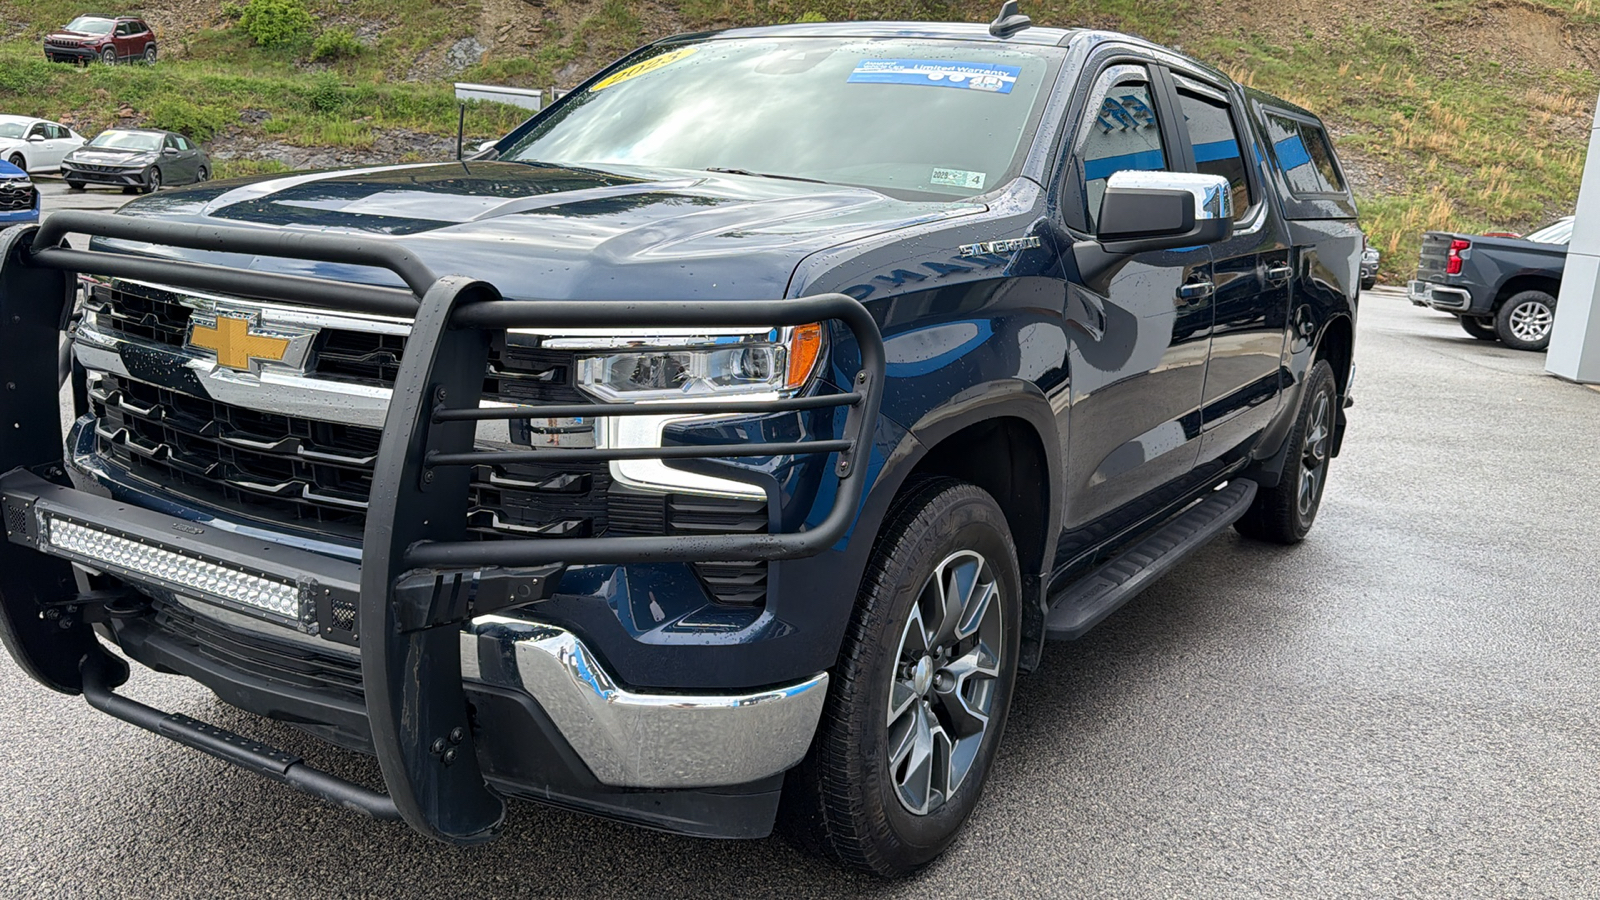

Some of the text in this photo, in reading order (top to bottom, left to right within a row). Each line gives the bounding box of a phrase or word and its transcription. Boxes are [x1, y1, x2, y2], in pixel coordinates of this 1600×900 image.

[608, 52, 682, 85] 2023
[913, 63, 1010, 77] Limited Warranty
[971, 175, 980, 185] 4
[958, 236, 1041, 258] SILVERADO
[907, 518, 948, 576] ALENZA
